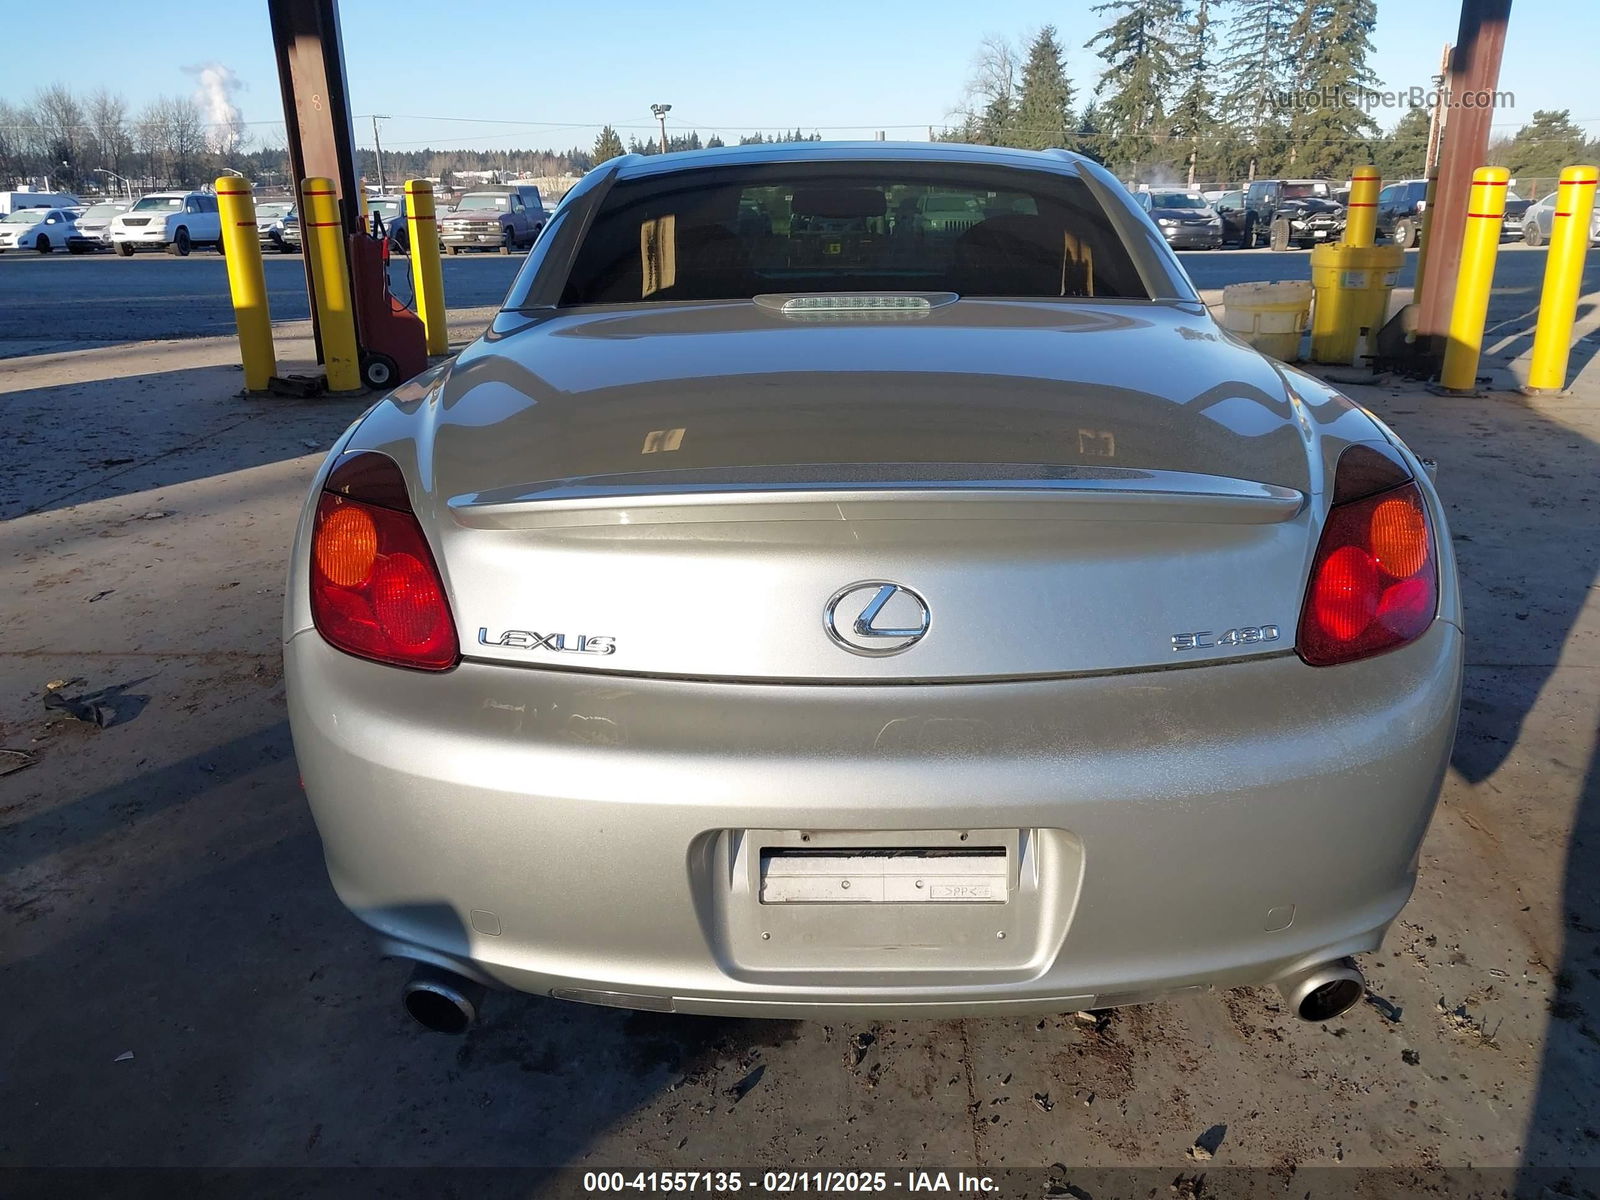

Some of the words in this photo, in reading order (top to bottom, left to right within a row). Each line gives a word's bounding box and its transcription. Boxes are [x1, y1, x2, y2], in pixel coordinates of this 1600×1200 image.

[311, 94, 322, 111] 8
[477, 626, 617, 656] LEXUS
[1171, 632, 1215, 652] SC
